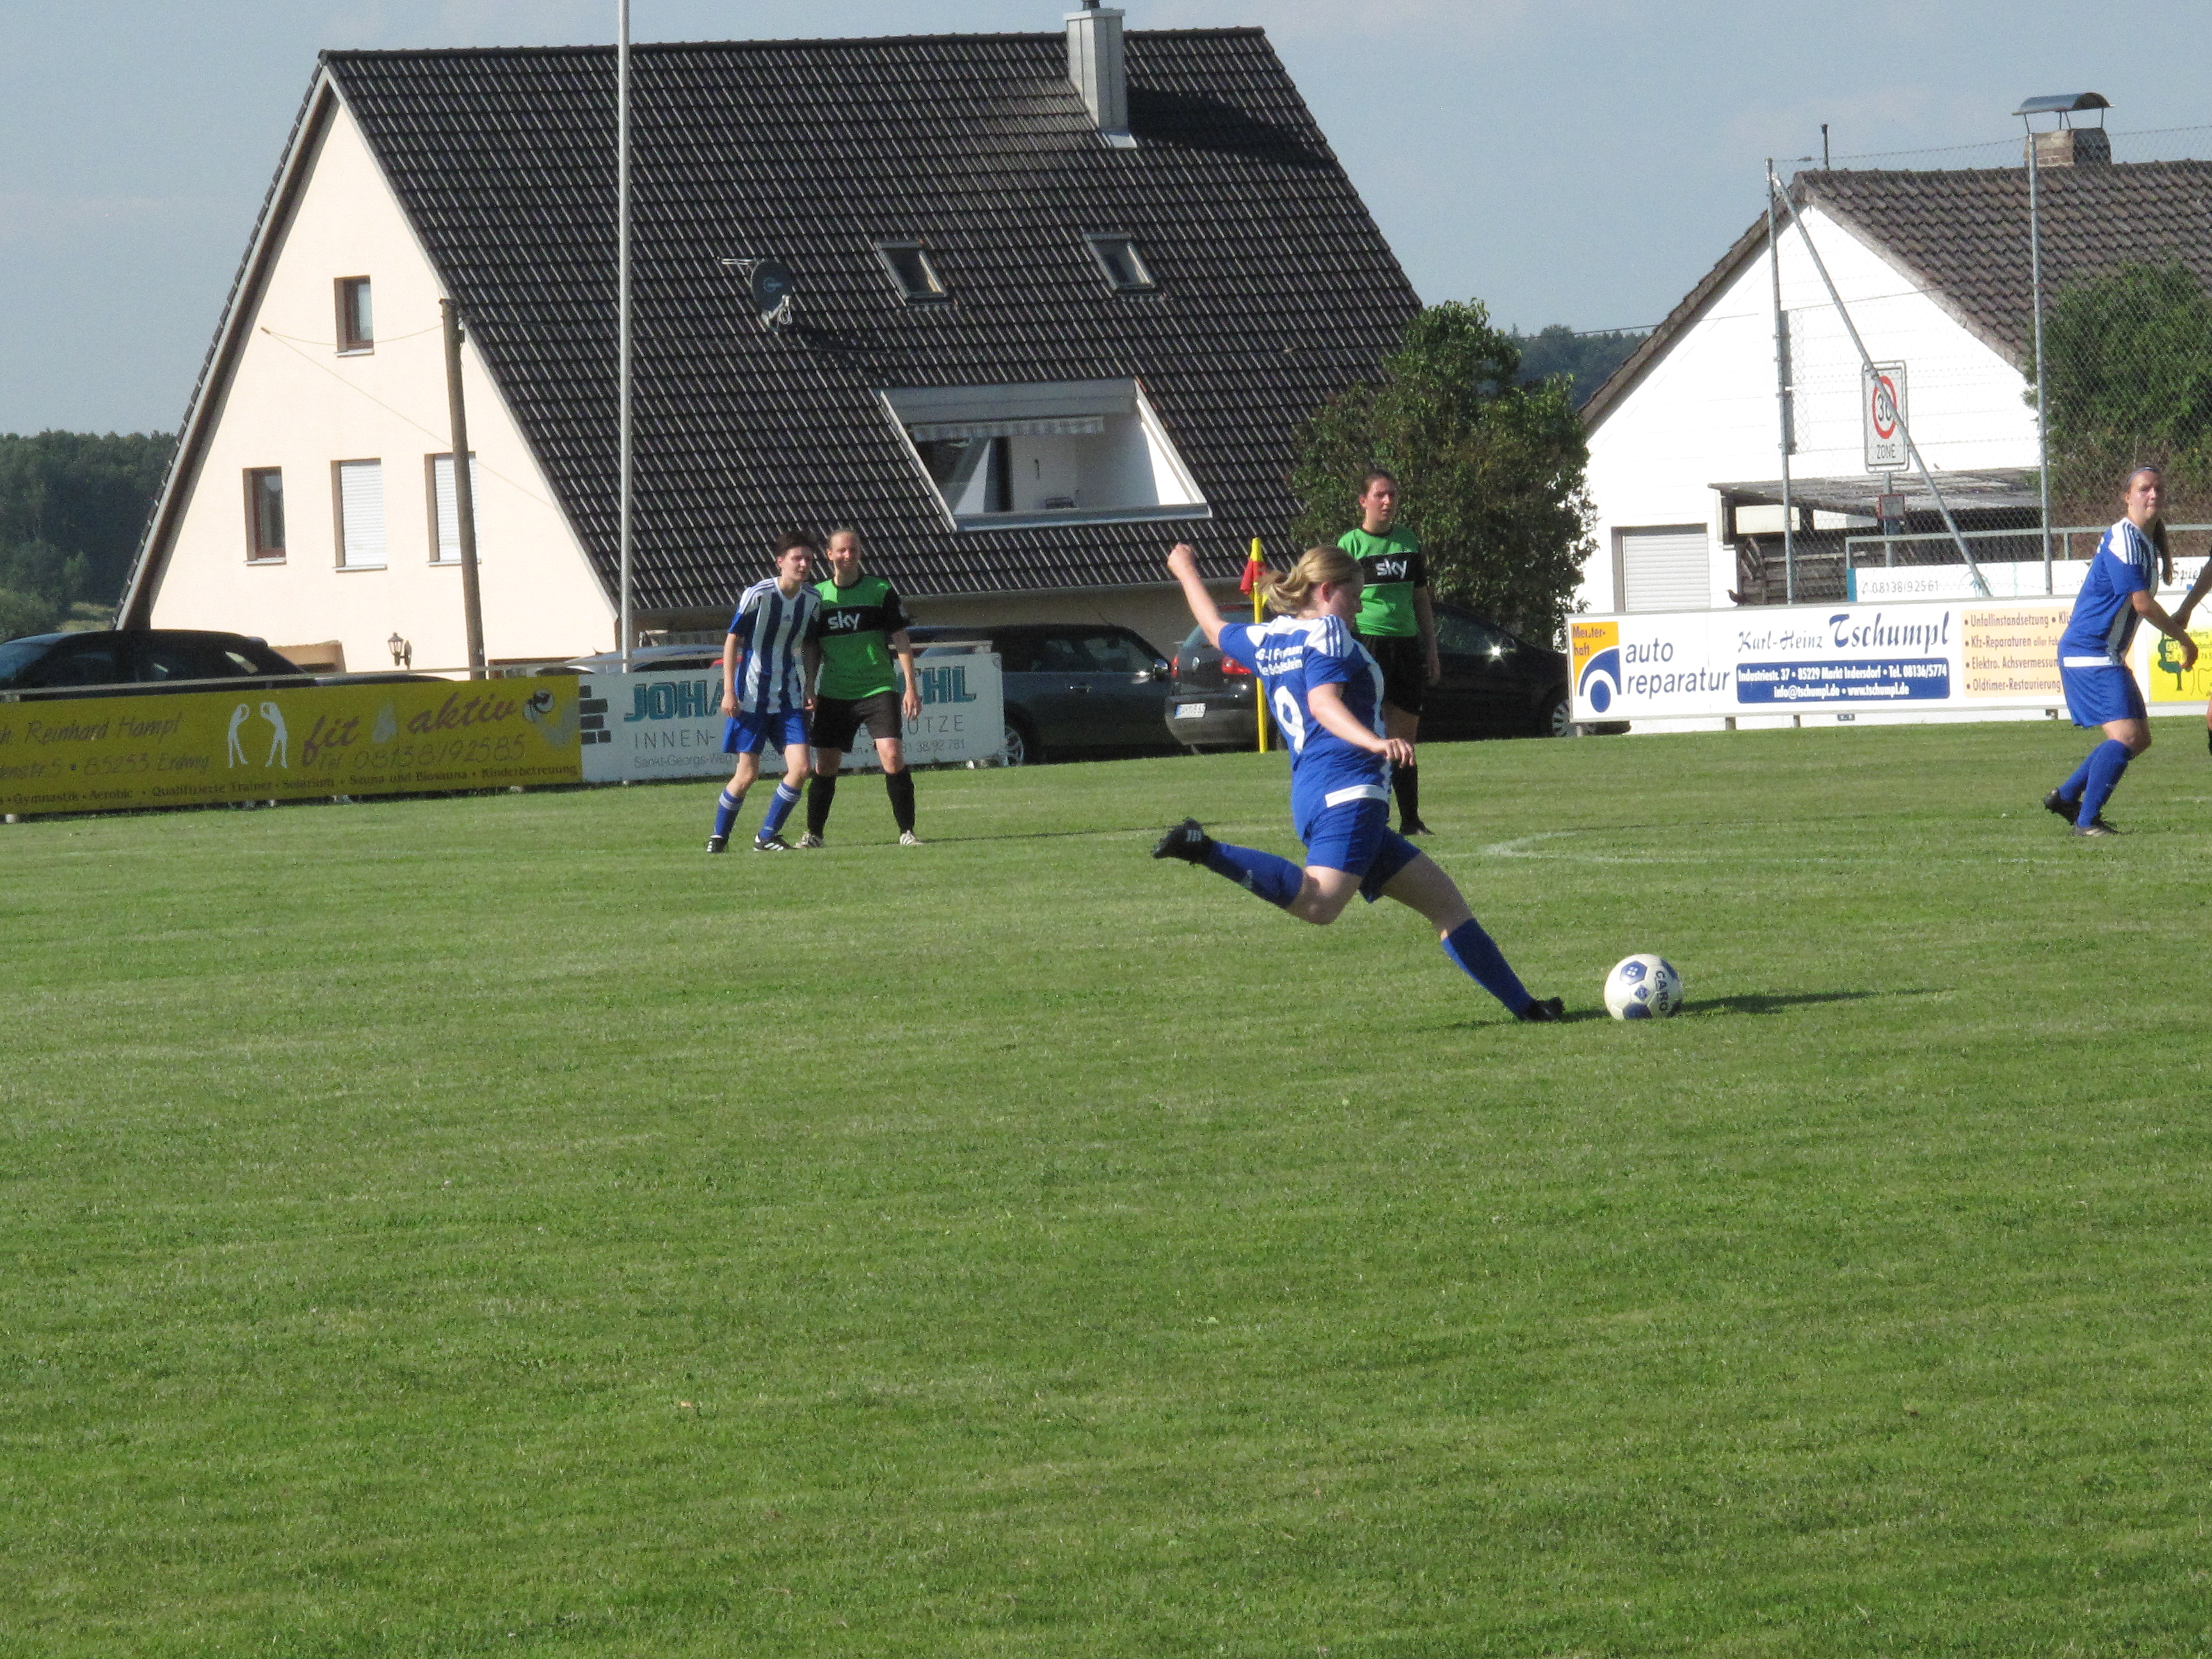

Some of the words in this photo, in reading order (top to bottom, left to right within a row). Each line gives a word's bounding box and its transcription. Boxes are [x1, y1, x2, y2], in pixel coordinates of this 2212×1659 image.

[1877, 444, 1896, 459] ZONE
[1375, 557, 1407, 579] sky
[827, 610, 861, 630] sky
[1970, 611, 2049, 629] Unfallinstandsetzung
[1738, 630, 1823, 652] Karl-Heinz
[1829, 611, 1950, 654] Tschumpl
[1971, 635, 2032, 650] Kfz-Reparaturen
[1573, 643, 1590, 656] haft
[1625, 637, 1674, 663] auto
[1781, 668, 1790, 681] 37
[1798, 668, 1820, 680] 85229
[1822, 666, 1843, 680] Markt
[1889, 665, 1902, 678] Tel.
[1903, 664, 1947, 678] 08136/5774
[1971, 656, 2000, 669] Elektro.
[2002, 656, 2058, 668] Achsvermessun
[1627, 667, 1731, 699] reparatur
[1774, 683, 1839, 700] info@tschumpl.de
[1848, 682, 1910, 698] www.tschumpl.de
[1973, 677, 2061, 693] Oldtimer-Restaurierung
[406, 691, 517, 733] aktiv
[1274, 685, 1305, 755] 9
[26, 717, 109, 745] Reinhard
[119, 710, 181, 744] Hampl
[301, 716, 363, 767] fit
[635, 728, 716, 749] INNEN-
[14, 791, 79, 805] Gymnastik
[90, 789, 132, 801] Aerobic
